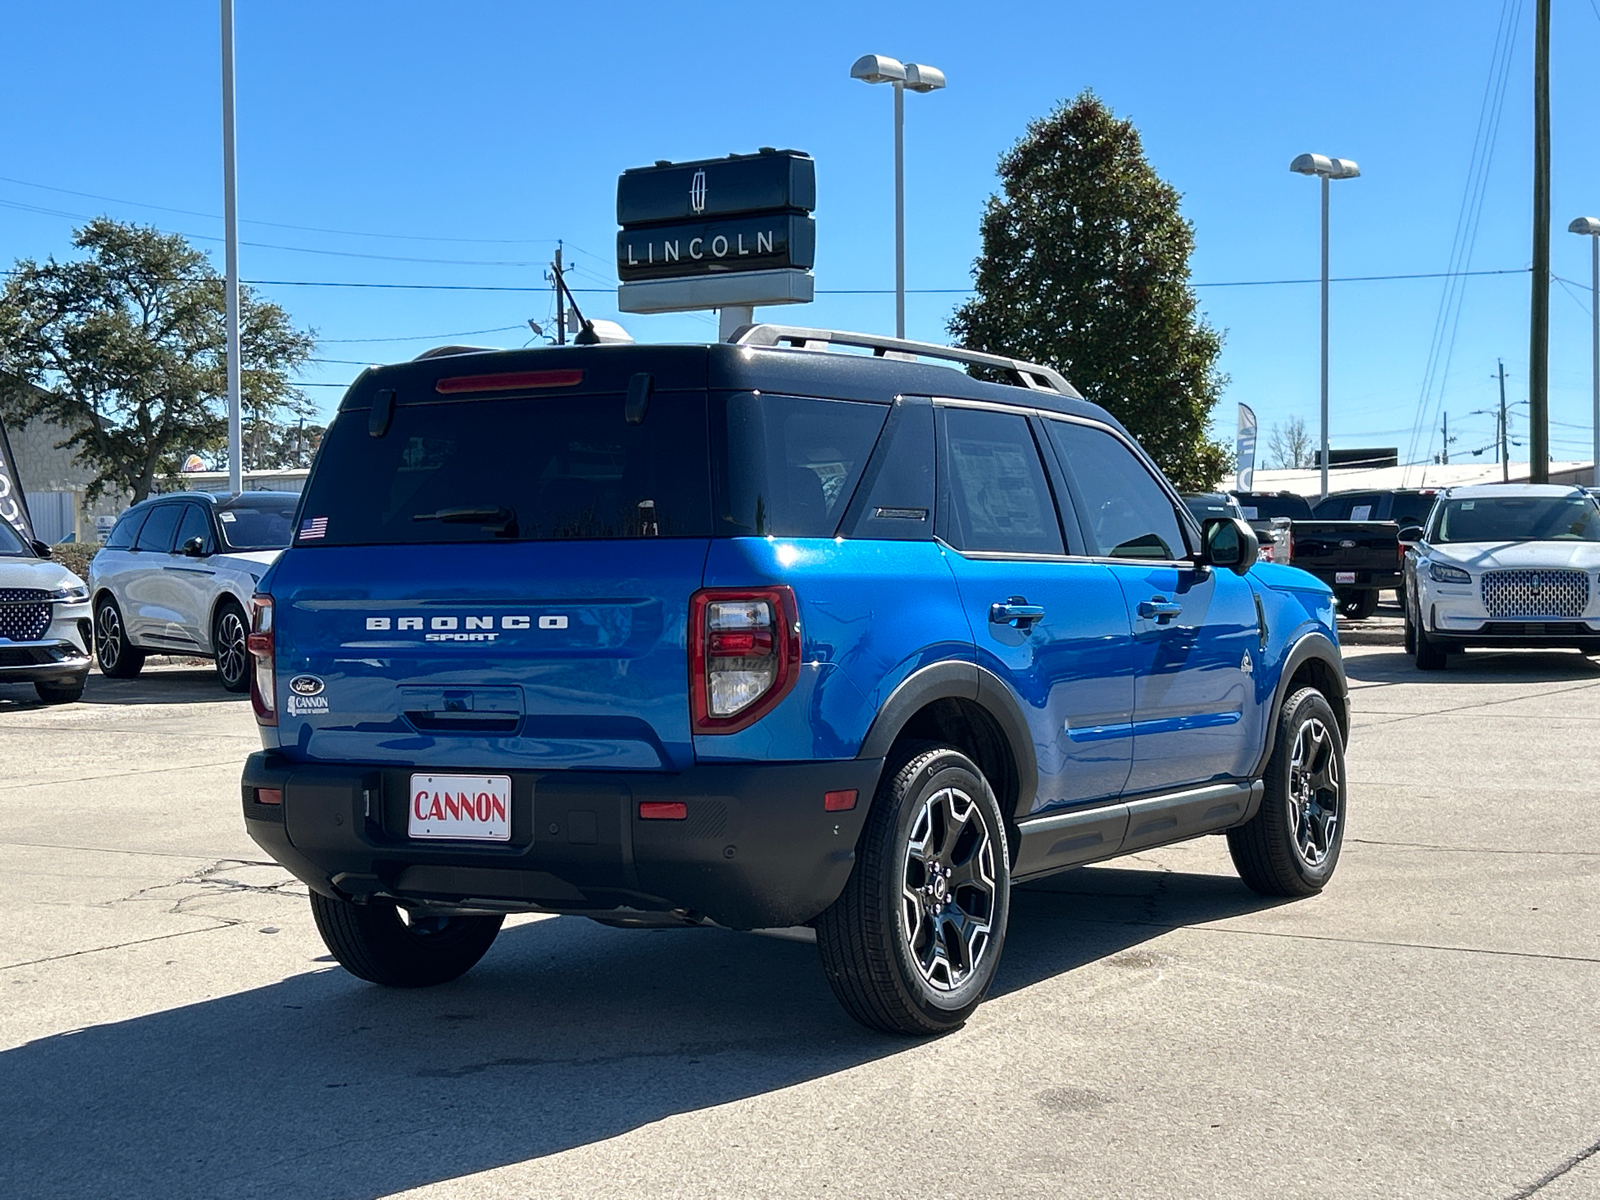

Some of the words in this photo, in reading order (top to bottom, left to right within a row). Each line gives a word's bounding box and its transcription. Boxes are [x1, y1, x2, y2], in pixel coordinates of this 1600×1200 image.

[628, 231, 773, 265] LINCOLN
[366, 615, 569, 631] BRONCO
[425, 633, 499, 641] SPORT
[296, 696, 328, 708] CANNON
[413, 790, 506, 823] CANNON
